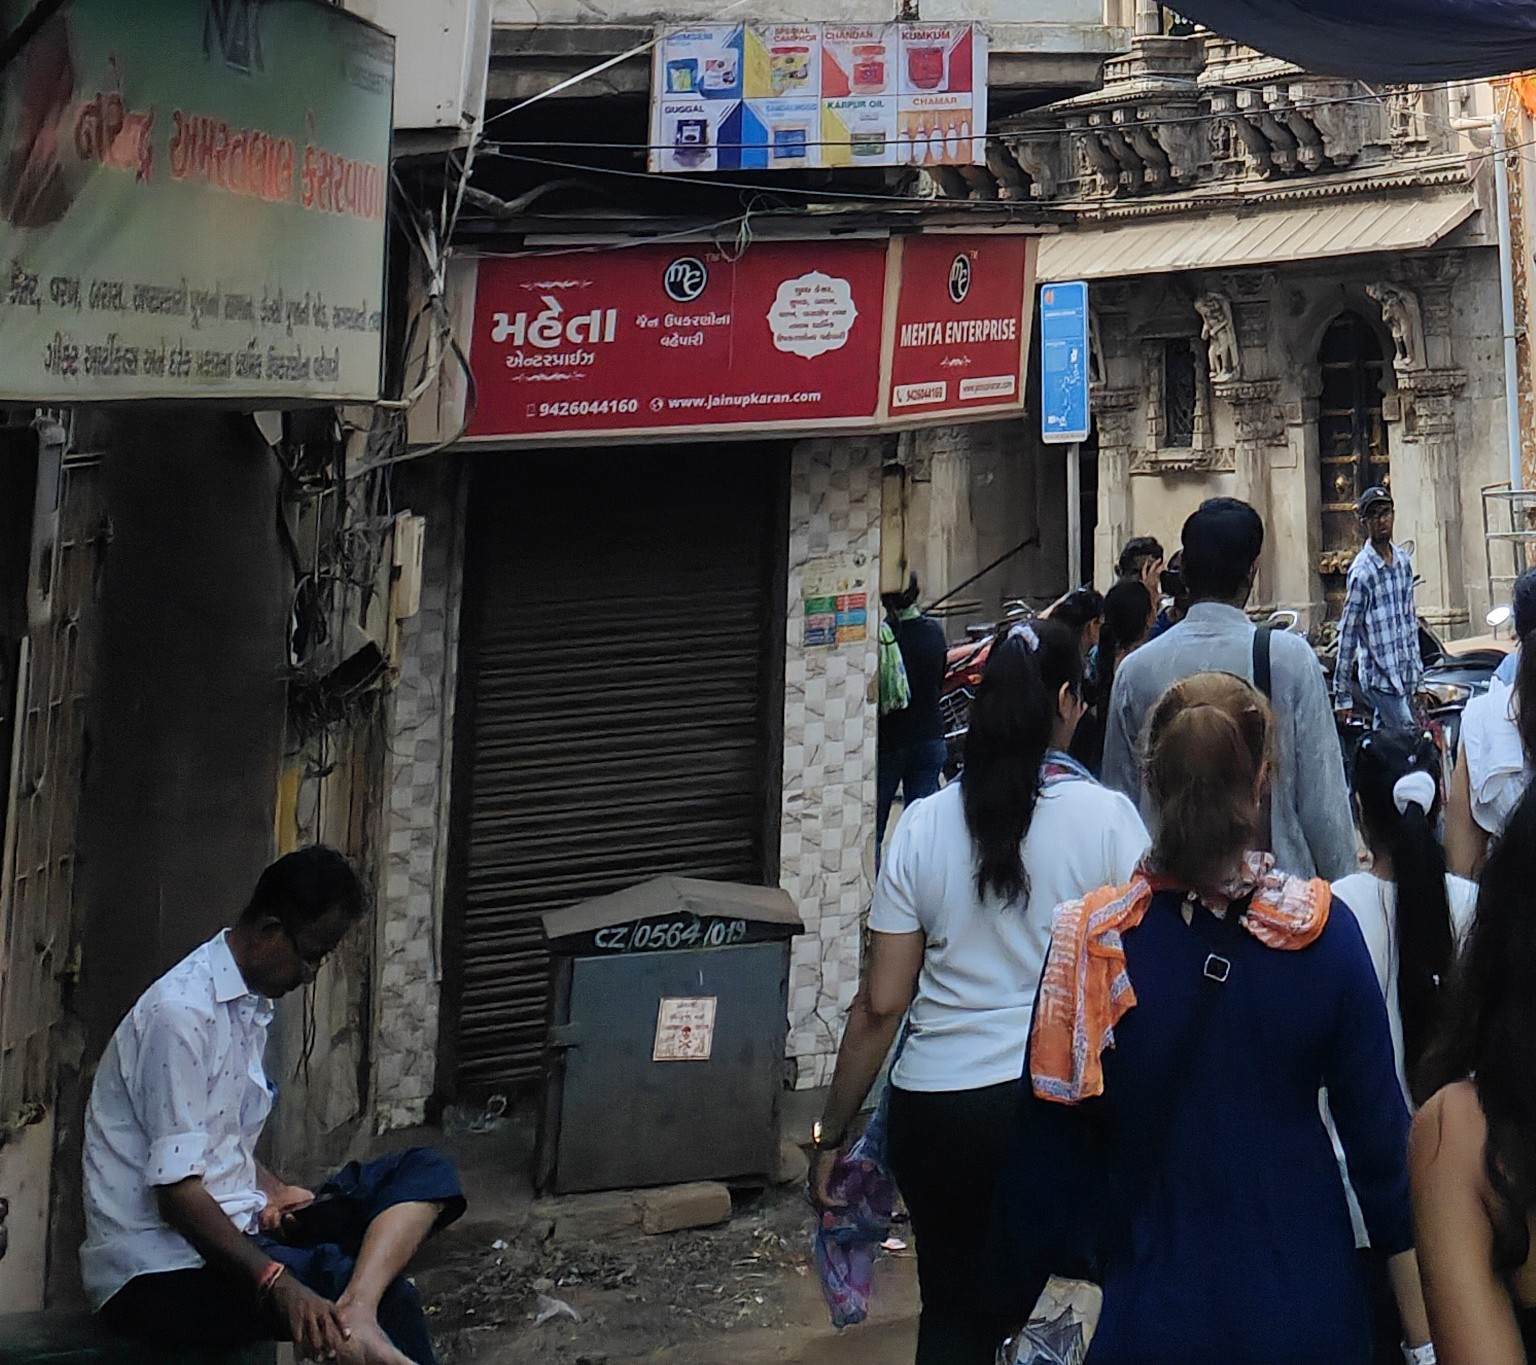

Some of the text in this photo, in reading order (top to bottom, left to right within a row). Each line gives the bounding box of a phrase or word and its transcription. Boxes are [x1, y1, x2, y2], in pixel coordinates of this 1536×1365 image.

[824, 29, 873, 40] CHANDAN
[901, 30, 951, 41] KUMKUM
[869, 100, 885, 108] OIL
[912, 97, 958, 106] CHAMAR
[491, 295, 617, 349] મહેતા
[899, 317, 1017, 348] MEHTA ENTERPRISE
[539, 399, 638, 417] 9426044160
[668, 391, 821, 411] www.jainupkaran.com
